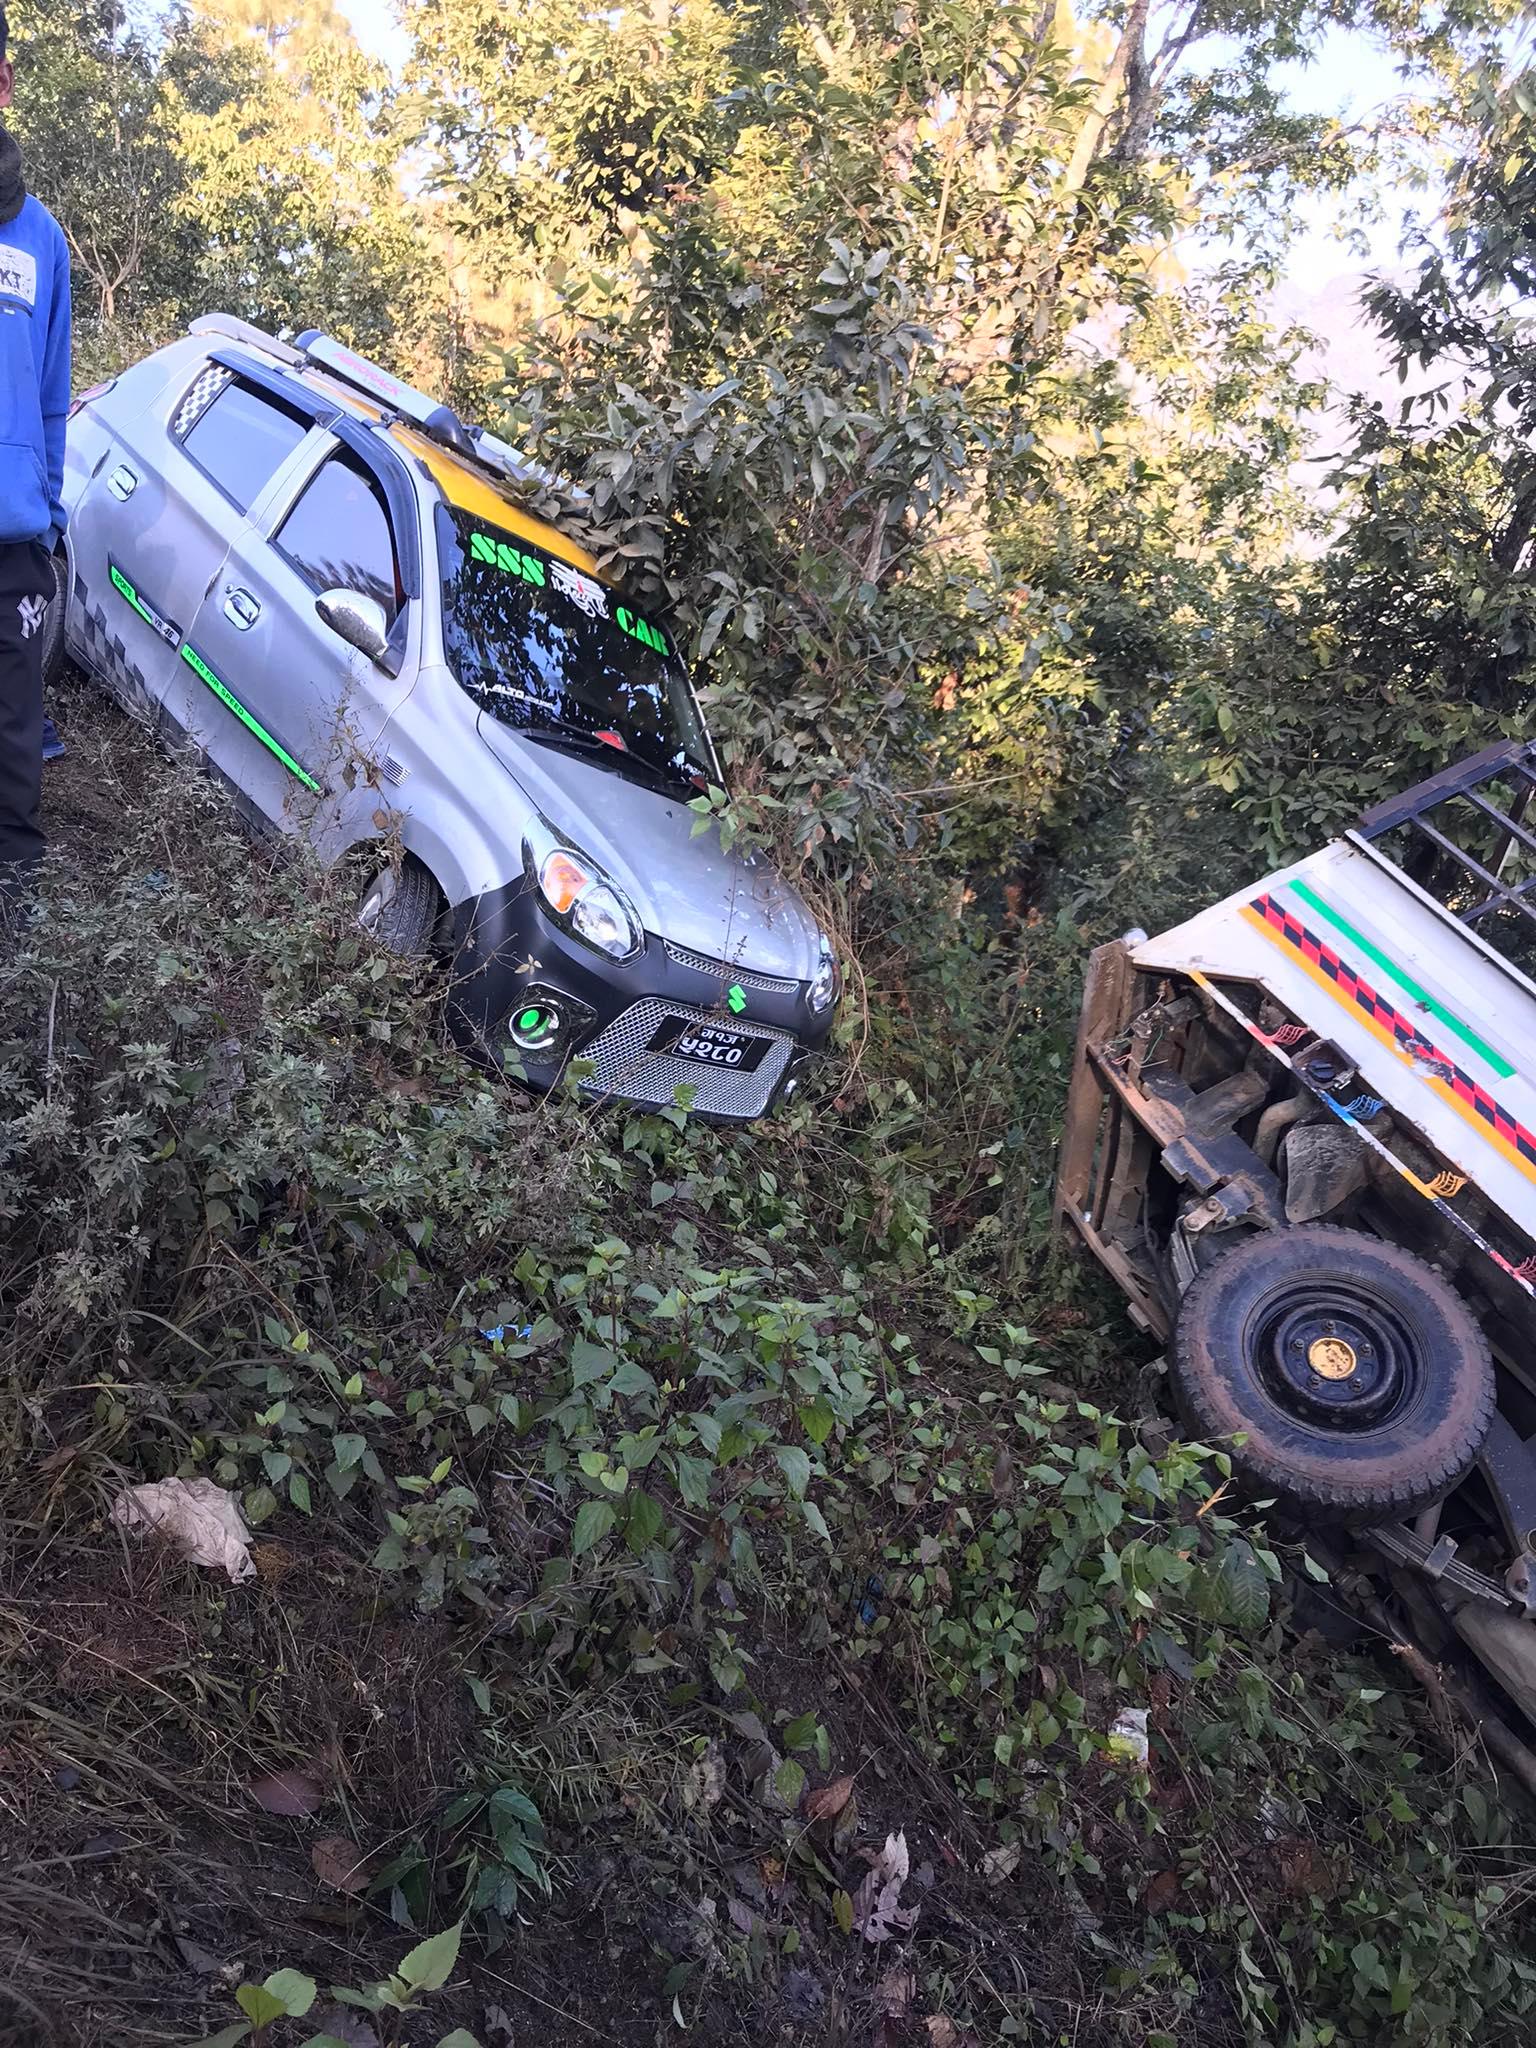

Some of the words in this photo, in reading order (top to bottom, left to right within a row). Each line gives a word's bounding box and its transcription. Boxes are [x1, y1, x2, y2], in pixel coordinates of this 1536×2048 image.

[470, 532, 546, 587] SSS
[114, 574, 133, 597] SPORTS
[187, 650, 205, 671] NEED
[205, 671, 220, 688] FOR
[221, 688, 244, 716] SPEED
[492, 684, 525, 700] ALTO
